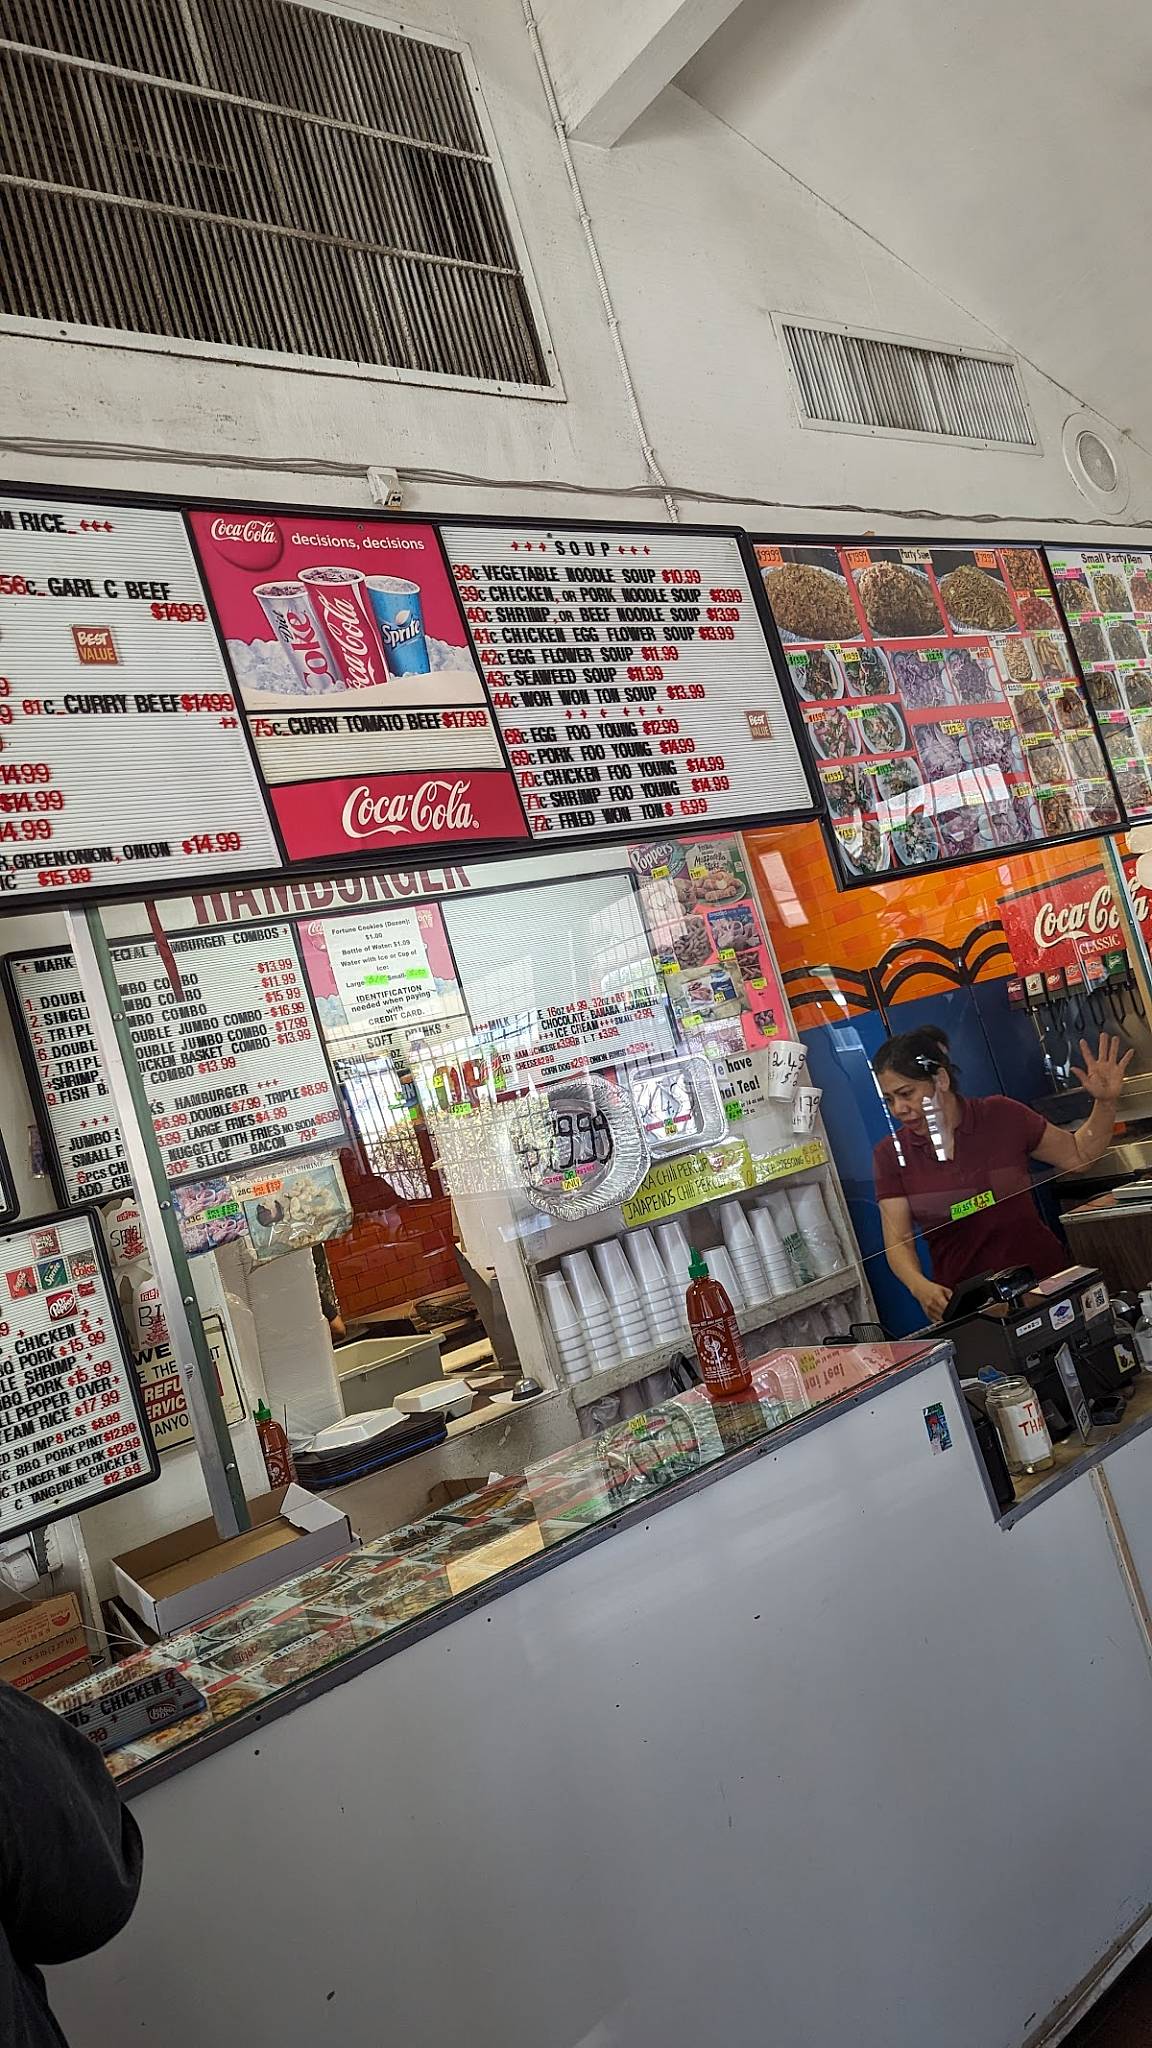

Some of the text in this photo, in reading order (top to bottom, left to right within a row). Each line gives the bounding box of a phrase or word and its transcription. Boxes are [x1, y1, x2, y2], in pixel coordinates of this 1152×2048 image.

[211, 518, 279, 543] Coca-Cola
[291, 532, 425, 550] decisions, decisions
[901, 549, 917, 562] Party
[1081, 553, 1127, 566] Small Party
[481, 565, 561, 582] VEGETABLE
[564, 567, 617, 583] NOODLE
[621, 568, 656, 583] SOUP
[661, 569, 702, 584] $10.99
[48, 577, 100, 598] GARL
[124, 581, 171, 600] BEEF
[562, 590, 578, 602] OR
[579, 587, 617, 602] PORK
[621, 588, 669, 602] NOODLE
[670, 588, 701, 602] SOUP
[558, 610, 575, 622] OR
[579, 607, 612, 622] BEEF
[616, 607, 666, 622] NOODLE
[670, 607, 701, 622] SOUP
[382, 617, 421, 648] Sprite
[501, 627, 567, 643] CHICKEN
[572, 627, 600, 642] EGG
[606, 626, 657, 641] FLOWER
[662, 626, 695, 641] SOUP
[77, 632, 115, 661] BEST VALUE
[506, 649, 536, 664] EGG
[541, 648, 596, 663] FLOWER
[599, 646, 634, 662] SOUP
[513, 669, 577, 686] SEAWEED
[582, 667, 617, 683] SOUP
[64, 694, 181, 714] CURRY BEEF
[558, 689, 591, 705] WON
[624, 686, 657, 702] SOUP
[666, 684, 706, 700] $13.99
[288, 717, 338, 735] CURRY
[343, 714, 404, 733] TOMATO
[407, 712, 444, 730] BEEF
[748, 715, 765, 726] BEST
[530, 726, 557, 743] EGG
[566, 724, 592, 741] FOO
[596, 722, 639, 739] YOUNG
[537, 747, 575, 764] PORK
[580, 744, 606, 761] FOO
[610, 742, 653, 759] YOUNG
[543, 766, 601, 787] CHICKEN
[607, 763, 633, 781] FOO
[637, 760, 678, 778] YOUNG
[686, 756, 725, 773] $14.99
[549, 788, 601, 808] SHRIMP
[608, 785, 634, 802] FOO
[640, 780, 681, 799] YOUNG
[691, 776, 730, 793] $14.99
[342, 780, 480, 838] Coca-Cola
[558, 810, 596, 829] FRIED
[602, 806, 632, 824] WON
[122, 832, 241, 860] ONION $14.99
[630, 842, 674, 874] Poppers
[233, 927, 280, 944] COMBOS
[1079, 934, 1121, 956] CLASSIC
[351, 991, 431, 1013] needed when paying
[356, 984, 423, 1003] IDENTIFICATION
[162, 1003, 207, 1022] COMBO
[368, 1014, 398, 1026] CREDIT
[385, 1005, 404, 1014] with
[178, 1009, 263, 1035] JUMBO COMBO
[488, 1016, 511, 1030] MILK
[554, 1026, 569, 1039] ICE
[571, 1020, 599, 1035] CREAM
[181, 1024, 268, 1051] JUMBO COMBO
[367, 1033, 393, 1049] SOFT
[181, 1046, 224, 1064] BASKET
[231, 1037, 270, 1055] COMBO
[150, 1056, 237, 1084] COMBO $13.99
[725, 1055, 753, 1073] have
[738, 1075, 760, 1095] Tea!
[60, 1089, 90, 1105] FISH
[174, 1084, 249, 1110] HAMBURGER
[265, 1087, 300, 1106] TRIPLE
[186, 1114, 256, 1140] LARGE FRIES
[168, 1118, 316, 1162] NUGGET WITH FRIES NO SODA
[196, 1150, 232, 1169] SLICE
[250, 1137, 287, 1155] BACON
[15, 1322, 77, 1355] CHICKEN
[19, 1345, 58, 1367] PORK
[134, 1343, 172, 1366] WE
[24, 1356, 77, 1386] SHRIMP
[151, 1360, 179, 1378] THE
[16, 1377, 112, 1423] PEPPER OVER
[26, 1377, 65, 1402] PORK
[39, 1389, 120, 1430] RICE $17.99
[64, 1424, 87, 1441] PCS
[16, 1435, 104, 1477] BBQ PORK PINT
[28, 1472, 89, 1504] TANGERINE
